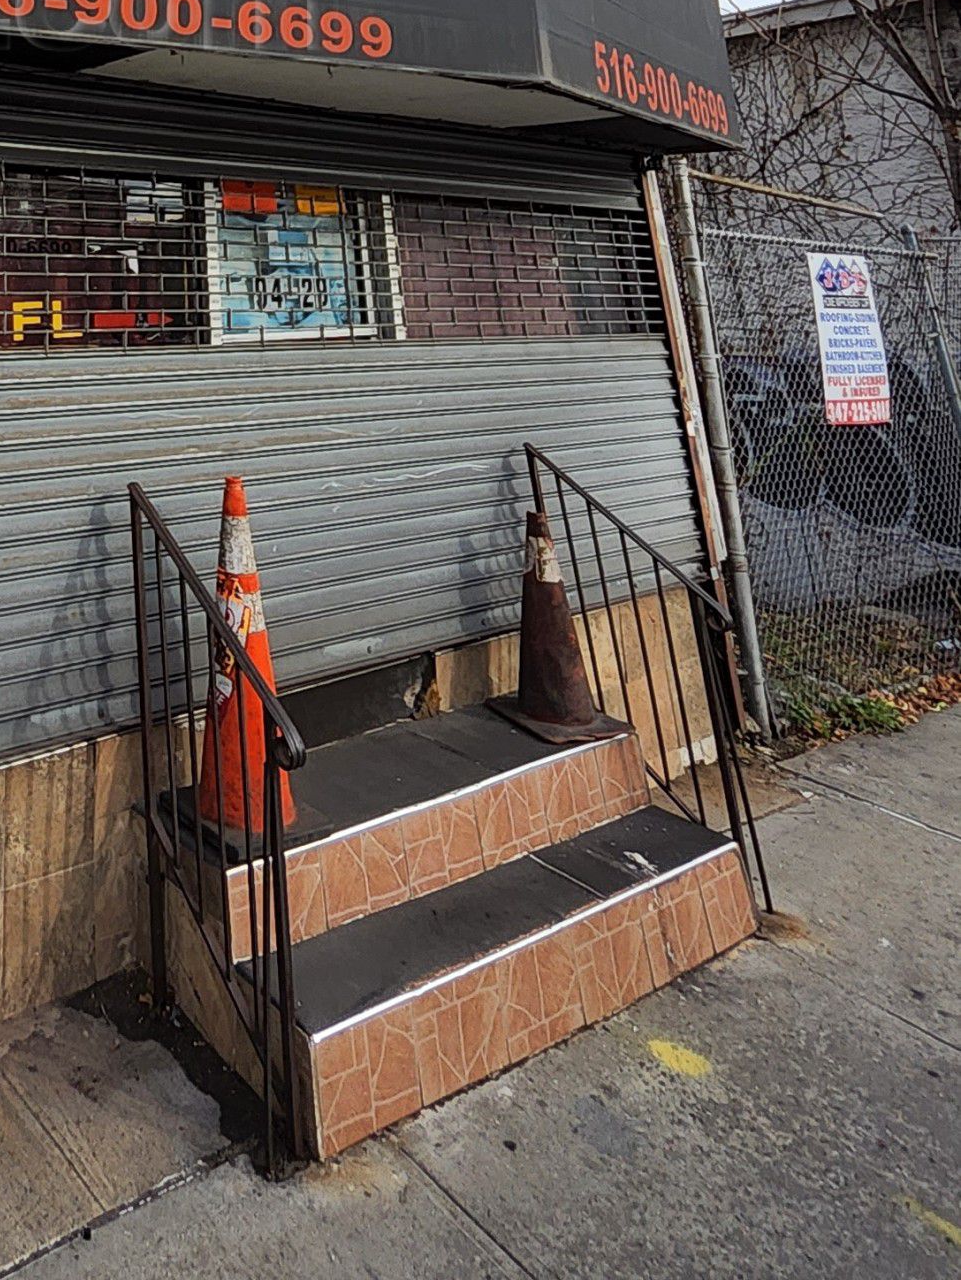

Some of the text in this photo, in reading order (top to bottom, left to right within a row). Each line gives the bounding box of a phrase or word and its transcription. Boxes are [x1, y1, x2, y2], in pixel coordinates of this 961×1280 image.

[593, 39, 729, 137] 516-900-6699
[833, 325, 870, 336] CONCRETE
[827, 375, 852, 387] FULLY
